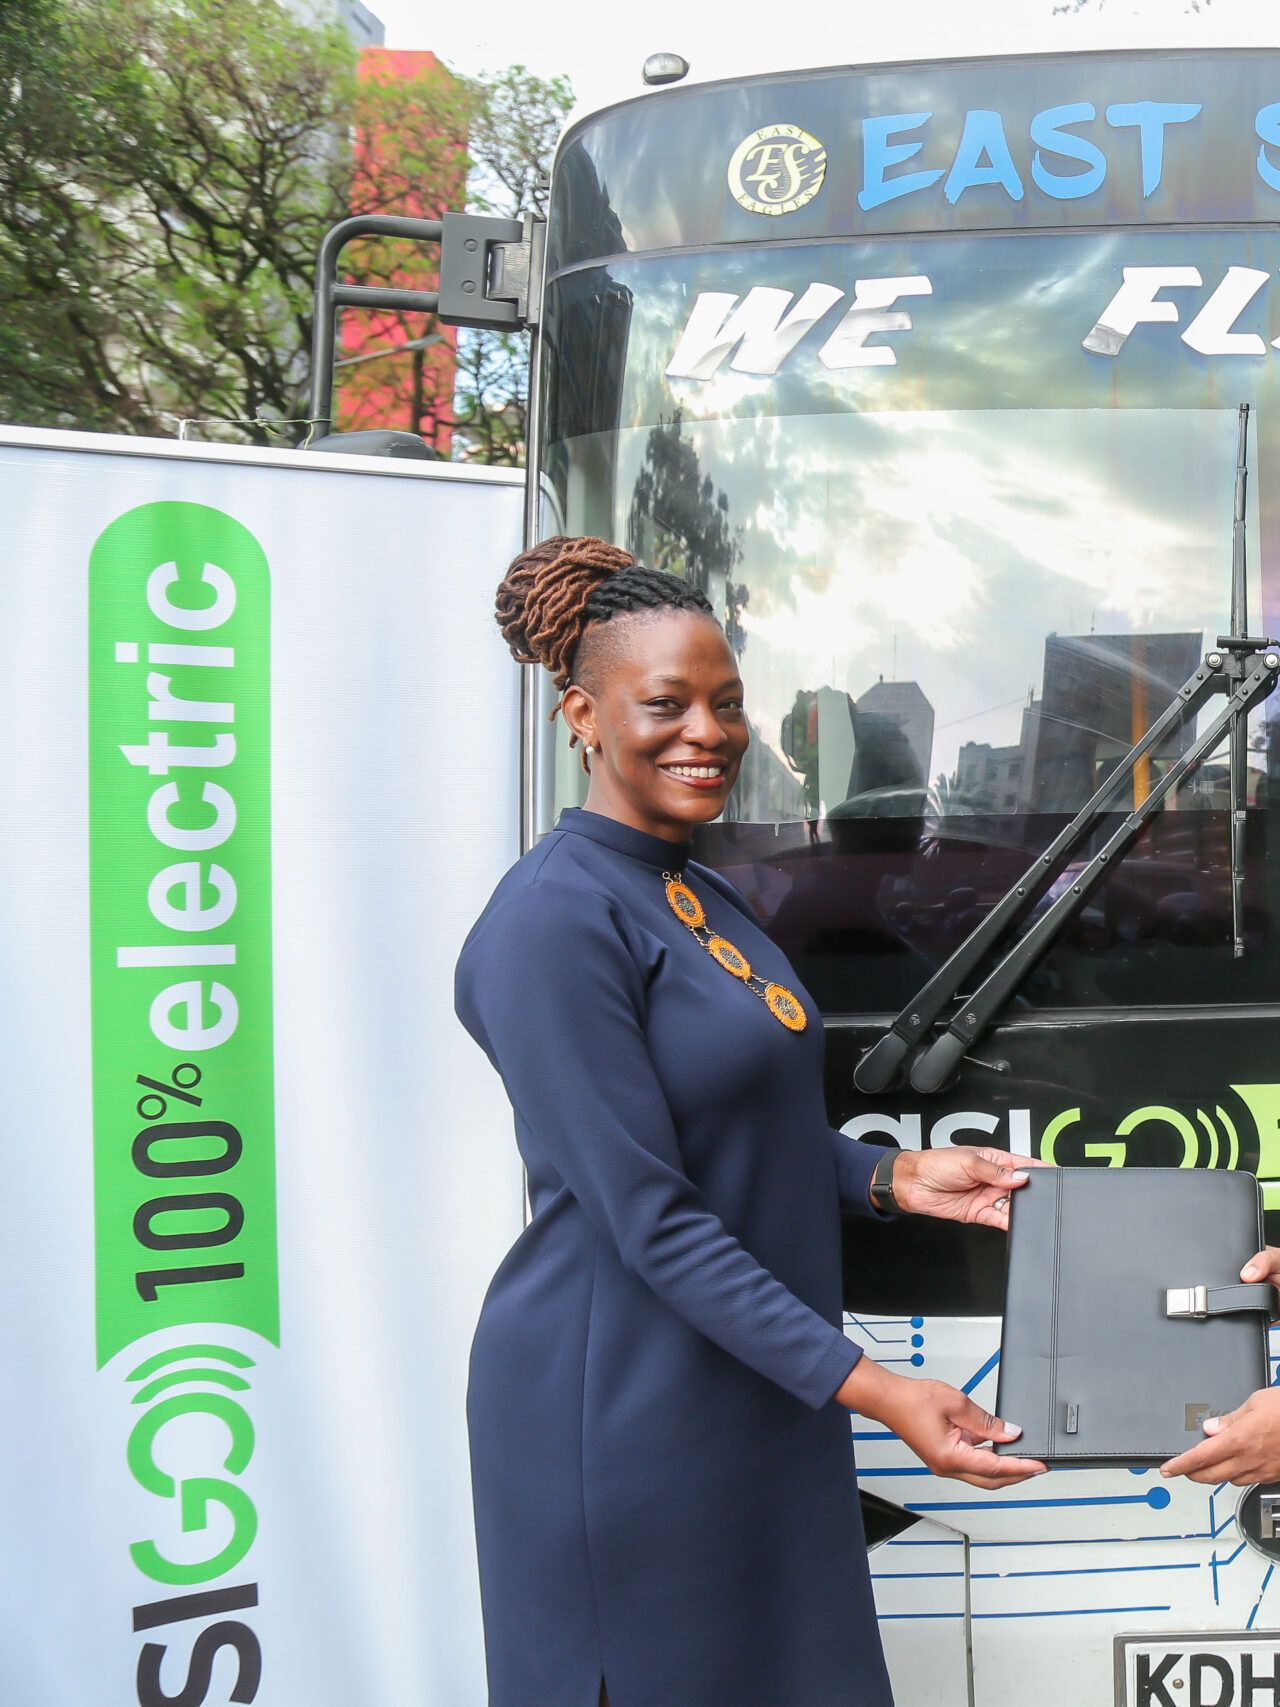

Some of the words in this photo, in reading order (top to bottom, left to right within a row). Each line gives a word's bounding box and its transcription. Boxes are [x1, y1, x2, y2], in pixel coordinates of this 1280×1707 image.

[757, 126, 805, 140] EAST
[857, 101, 1202, 211] EAST
[738, 189, 814, 215] EAGLES
[665, 275, 933, 381] WE
[115, 560, 240, 1052] electric
[131, 1063, 245, 1302] 100%
